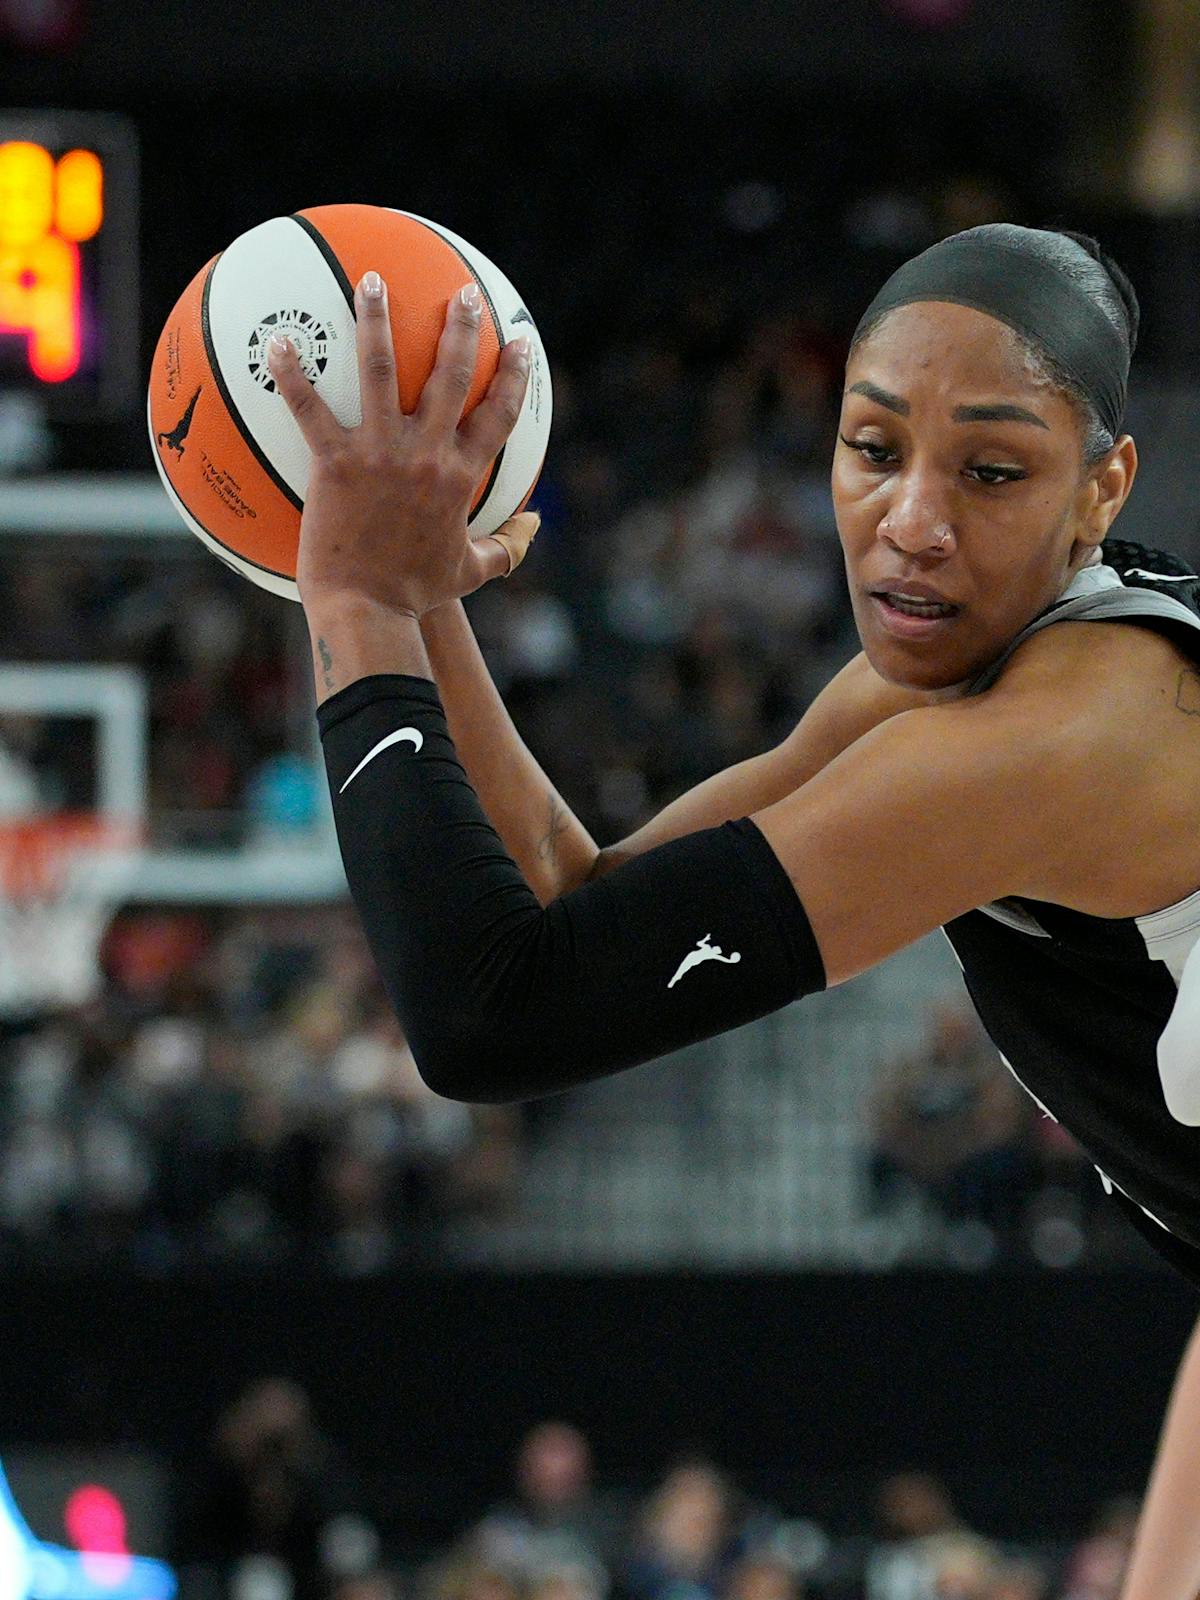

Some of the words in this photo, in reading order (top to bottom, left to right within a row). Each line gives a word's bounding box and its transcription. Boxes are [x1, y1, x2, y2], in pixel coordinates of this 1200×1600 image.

[200, 451, 225, 485] BALL
[202, 466, 244, 518] OFFICIAL
[223, 485, 256, 518] GAME
